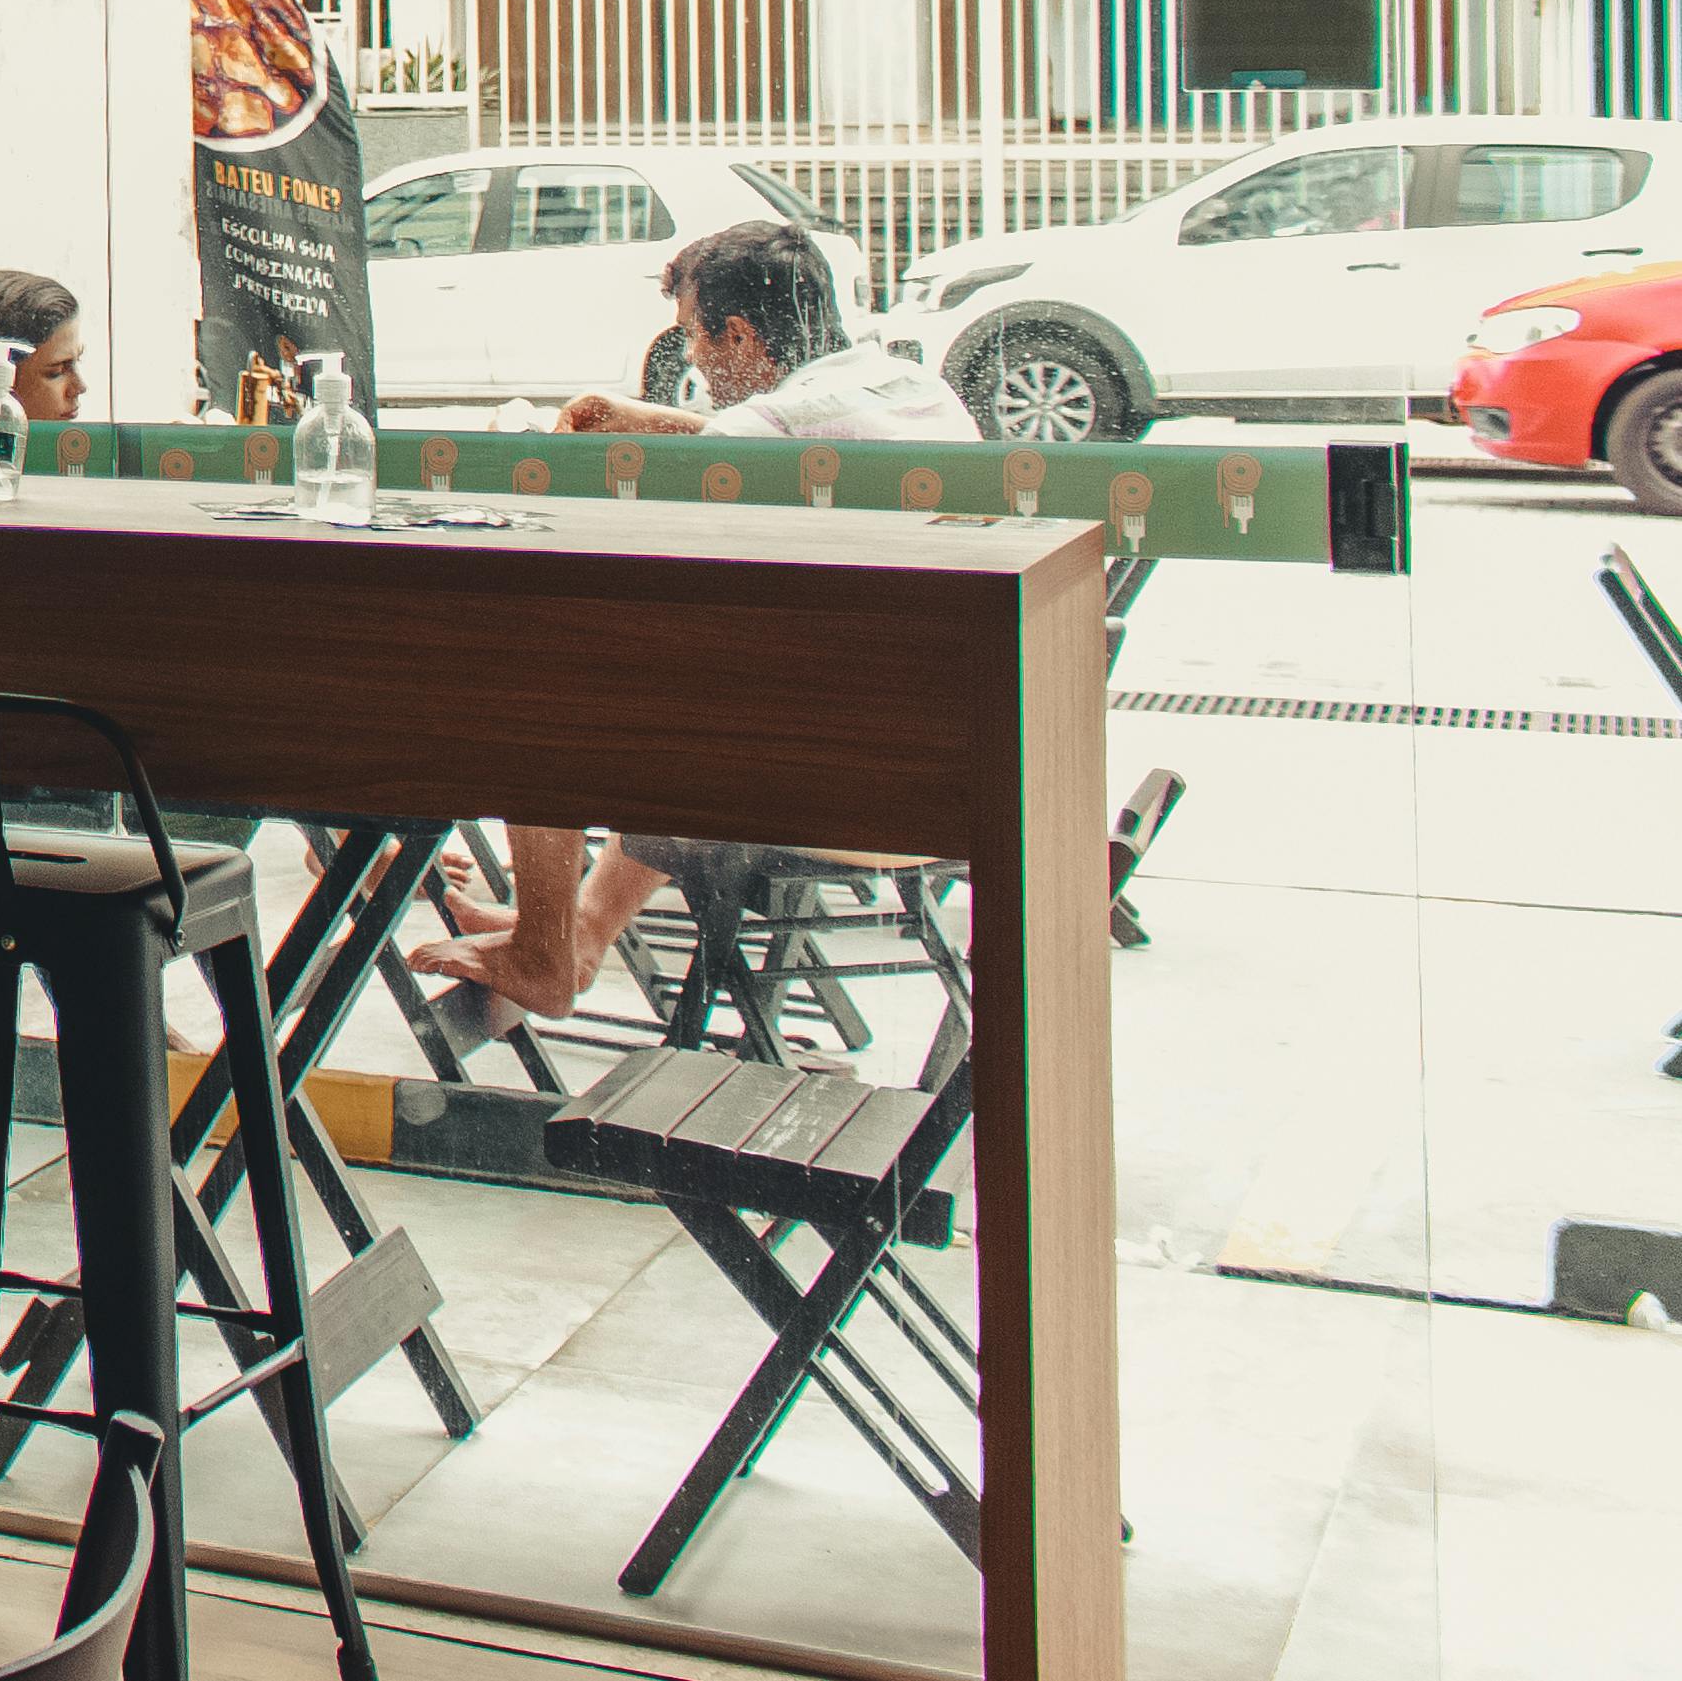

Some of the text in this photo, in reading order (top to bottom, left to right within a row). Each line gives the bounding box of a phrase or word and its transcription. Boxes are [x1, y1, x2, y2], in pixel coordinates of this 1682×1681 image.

[213, 159, 343, 213] BATEU FOME?
[221, 216, 296, 255] ESCOLHA
[298, 239, 337, 263] SUA
